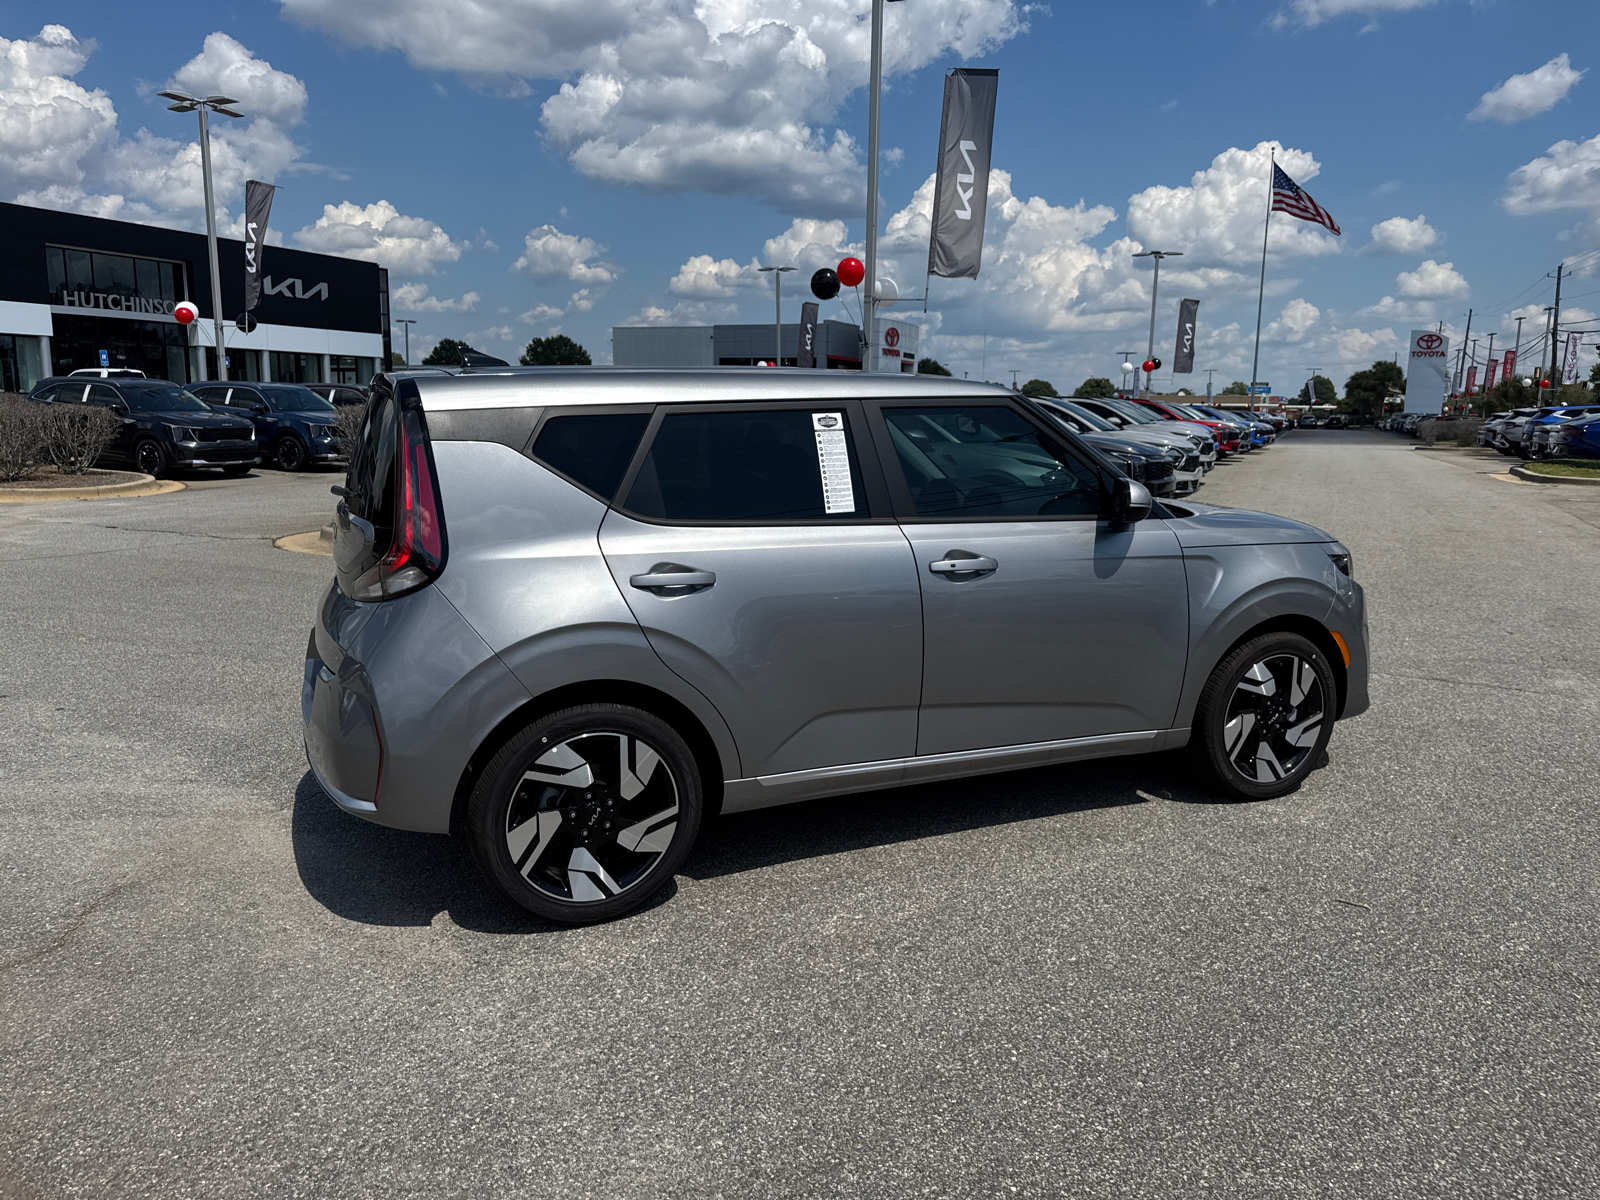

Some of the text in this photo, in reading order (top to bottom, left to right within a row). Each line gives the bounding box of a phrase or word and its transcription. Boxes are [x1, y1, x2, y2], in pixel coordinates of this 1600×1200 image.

[954, 140, 977, 220] KIA
[246, 222, 258, 273] KIA
[63, 290, 179, 315] HUTCHINSO
[263, 275, 328, 301] KIA
[1567, 345, 1578, 381] TOYOTA
